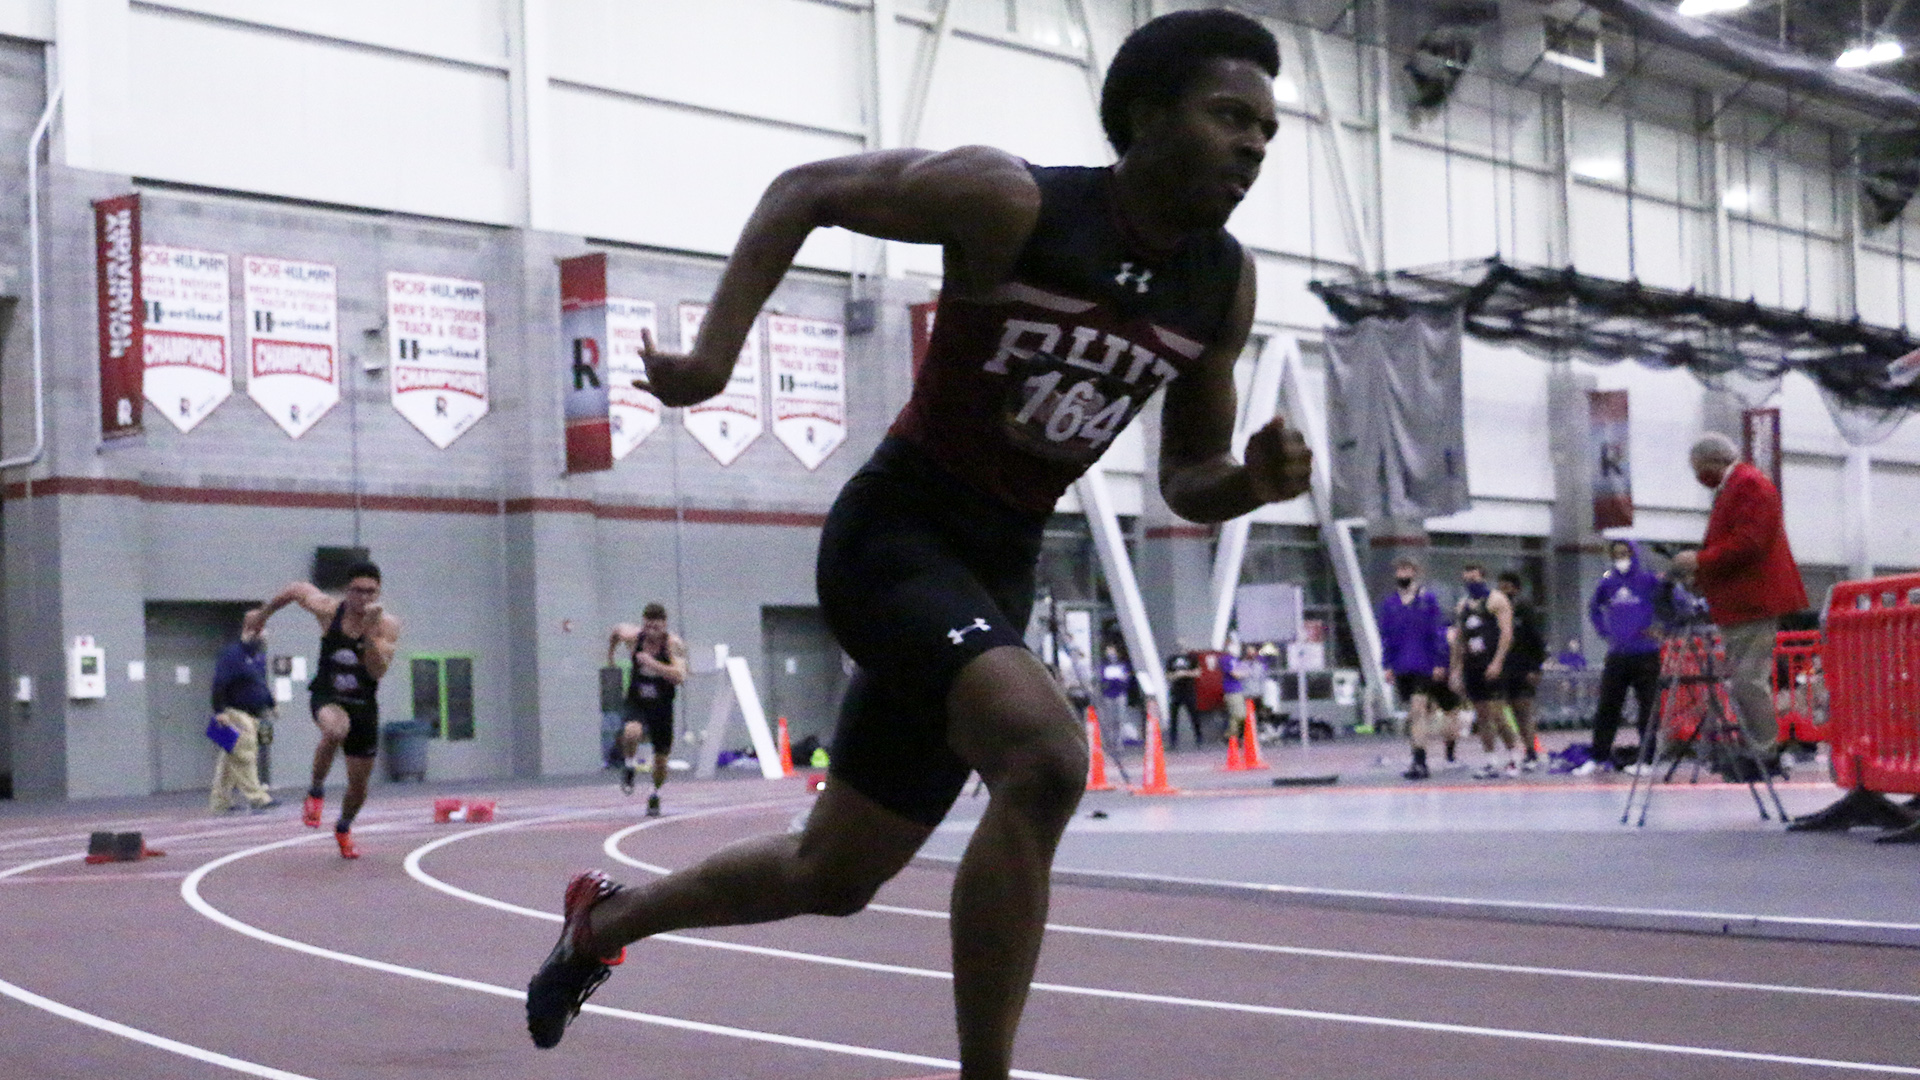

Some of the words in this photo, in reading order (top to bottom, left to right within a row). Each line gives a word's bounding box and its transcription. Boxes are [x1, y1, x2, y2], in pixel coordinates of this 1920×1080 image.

[256, 343, 331, 378] CHAMPIONS
[573, 338, 601, 390] R
[116, 398, 133, 426] R
[1014, 370, 1132, 450] 164
